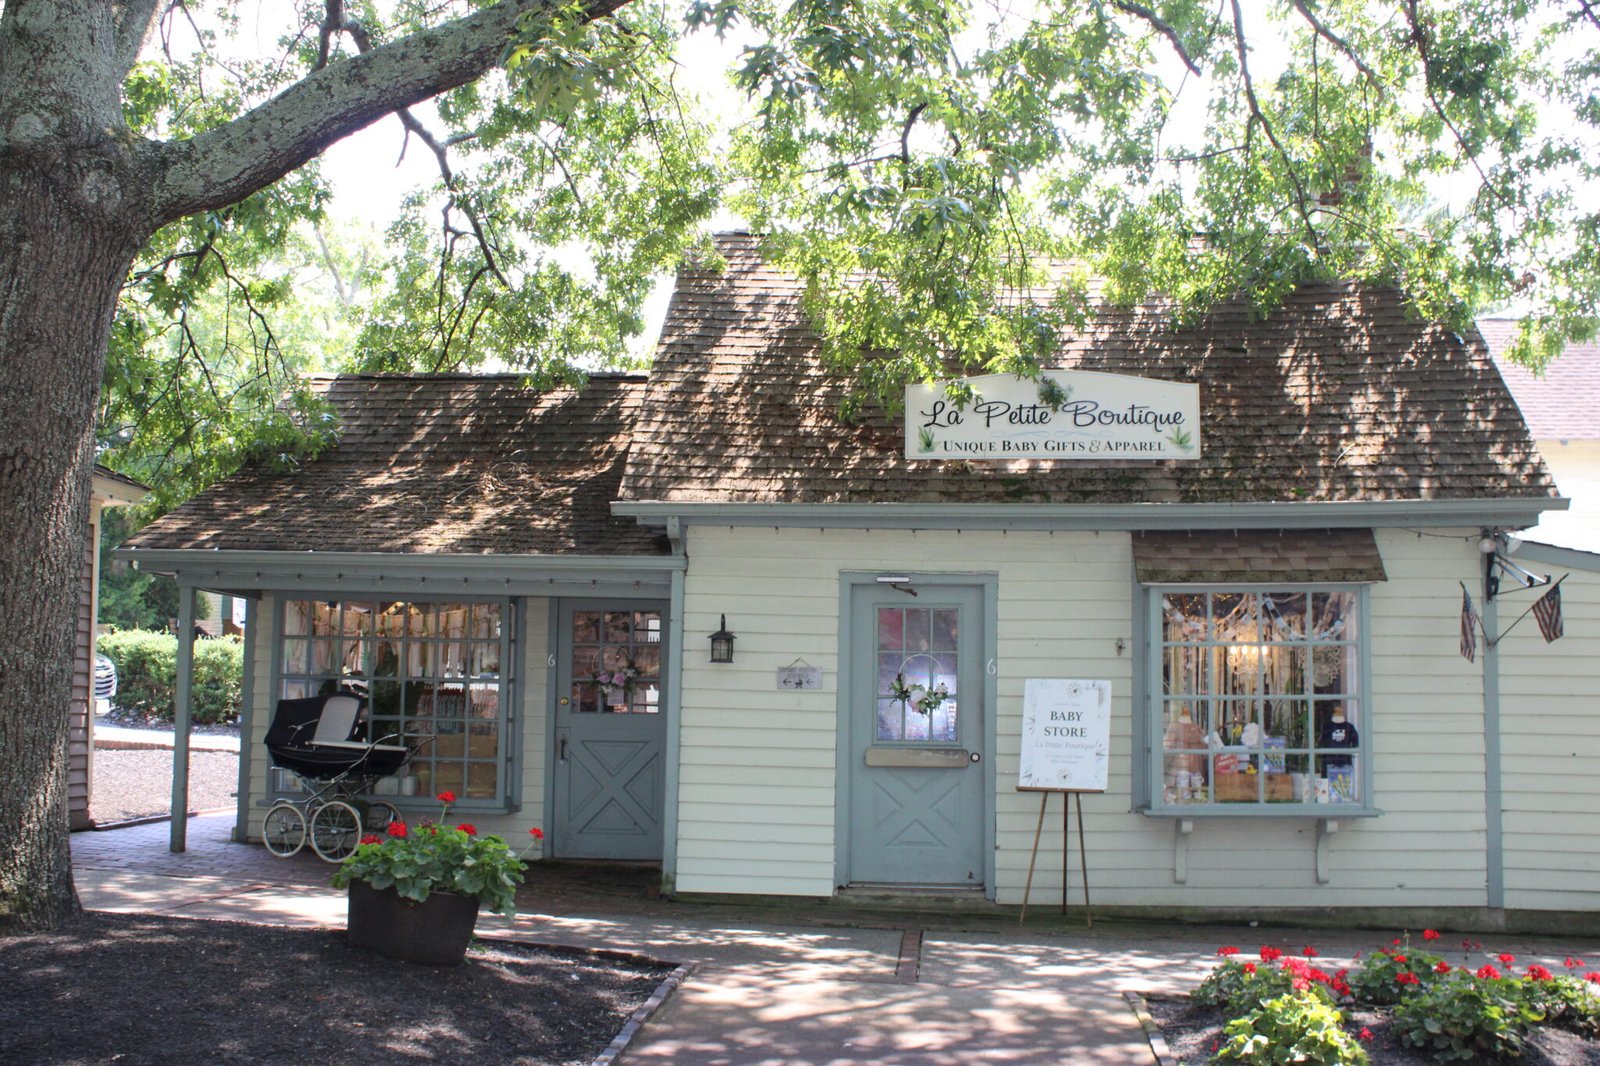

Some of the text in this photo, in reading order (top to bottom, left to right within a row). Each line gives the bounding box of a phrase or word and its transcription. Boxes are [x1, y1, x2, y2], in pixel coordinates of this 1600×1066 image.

[920, 400, 1186, 432] La Petite Boutique
[943, 439, 1166, 453] UNIQUE BABY GIFTS & APPAREL
[547, 653, 556, 667] 6
[986, 658, 996, 675] 6
[1050, 711, 1083, 721] BABY
[1044, 726, 1087, 737] STORE
